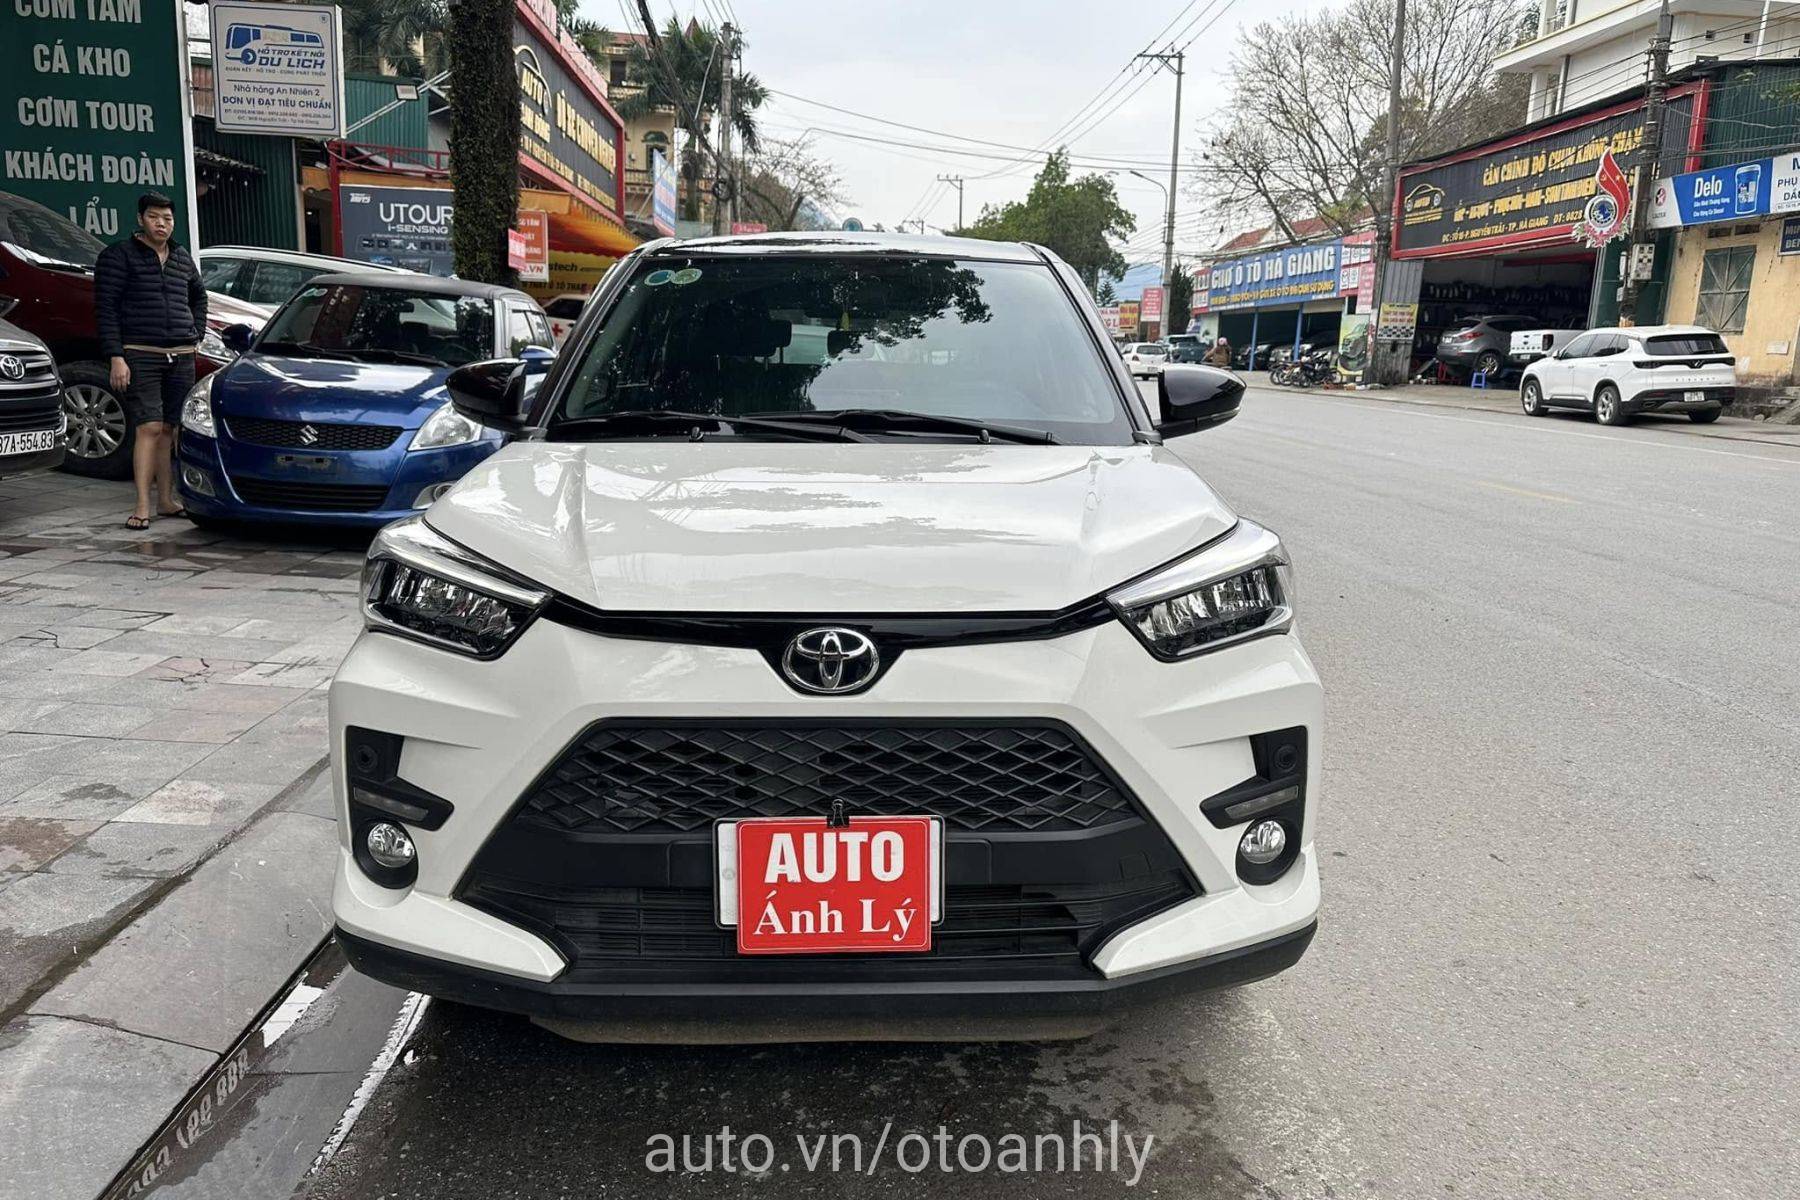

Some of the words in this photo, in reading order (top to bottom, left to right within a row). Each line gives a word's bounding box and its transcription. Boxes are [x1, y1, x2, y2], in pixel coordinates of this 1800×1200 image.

[33, 38, 71, 74] CÁ
[77, 46, 131, 78] KHO
[258, 56, 282, 67] DU
[287, 59, 325, 70] LỊCH
[222, 95, 244, 105] ĐƠN
[245, 98, 256, 108] VỊ
[257, 98, 276, 110] ĐẠT
[278, 97, 296, 108] TIÊU
[298, 97, 332, 109] CHUẨN
[276, 87, 288, 95] An
[289, 87, 313, 96] Nhiên
[18, 96, 79, 128] CƠM
[85, 101, 155, 133] TOUR
[5, 147, 95, 182] KHÁCH
[101, 151, 175, 187] ĐOÀN
[1777, 176, 1798, 188] PHỤ
[1694, 174, 1723, 199] Delo
[68, 196, 119, 236] LẨU
[549, 262, 578, 272] stech
[1211, 265, 1234, 292] CHỢ
[1235, 261, 1243, 286] Ô
[1246, 256, 1262, 284] TÔ
[1265, 252, 1284, 281] HÀ
[1287, 246, 1336, 278] GIANG
[764, 830, 905, 884] AUTO
[753, 889, 845, 936] Ánh
[858, 897, 918, 942] Lý
